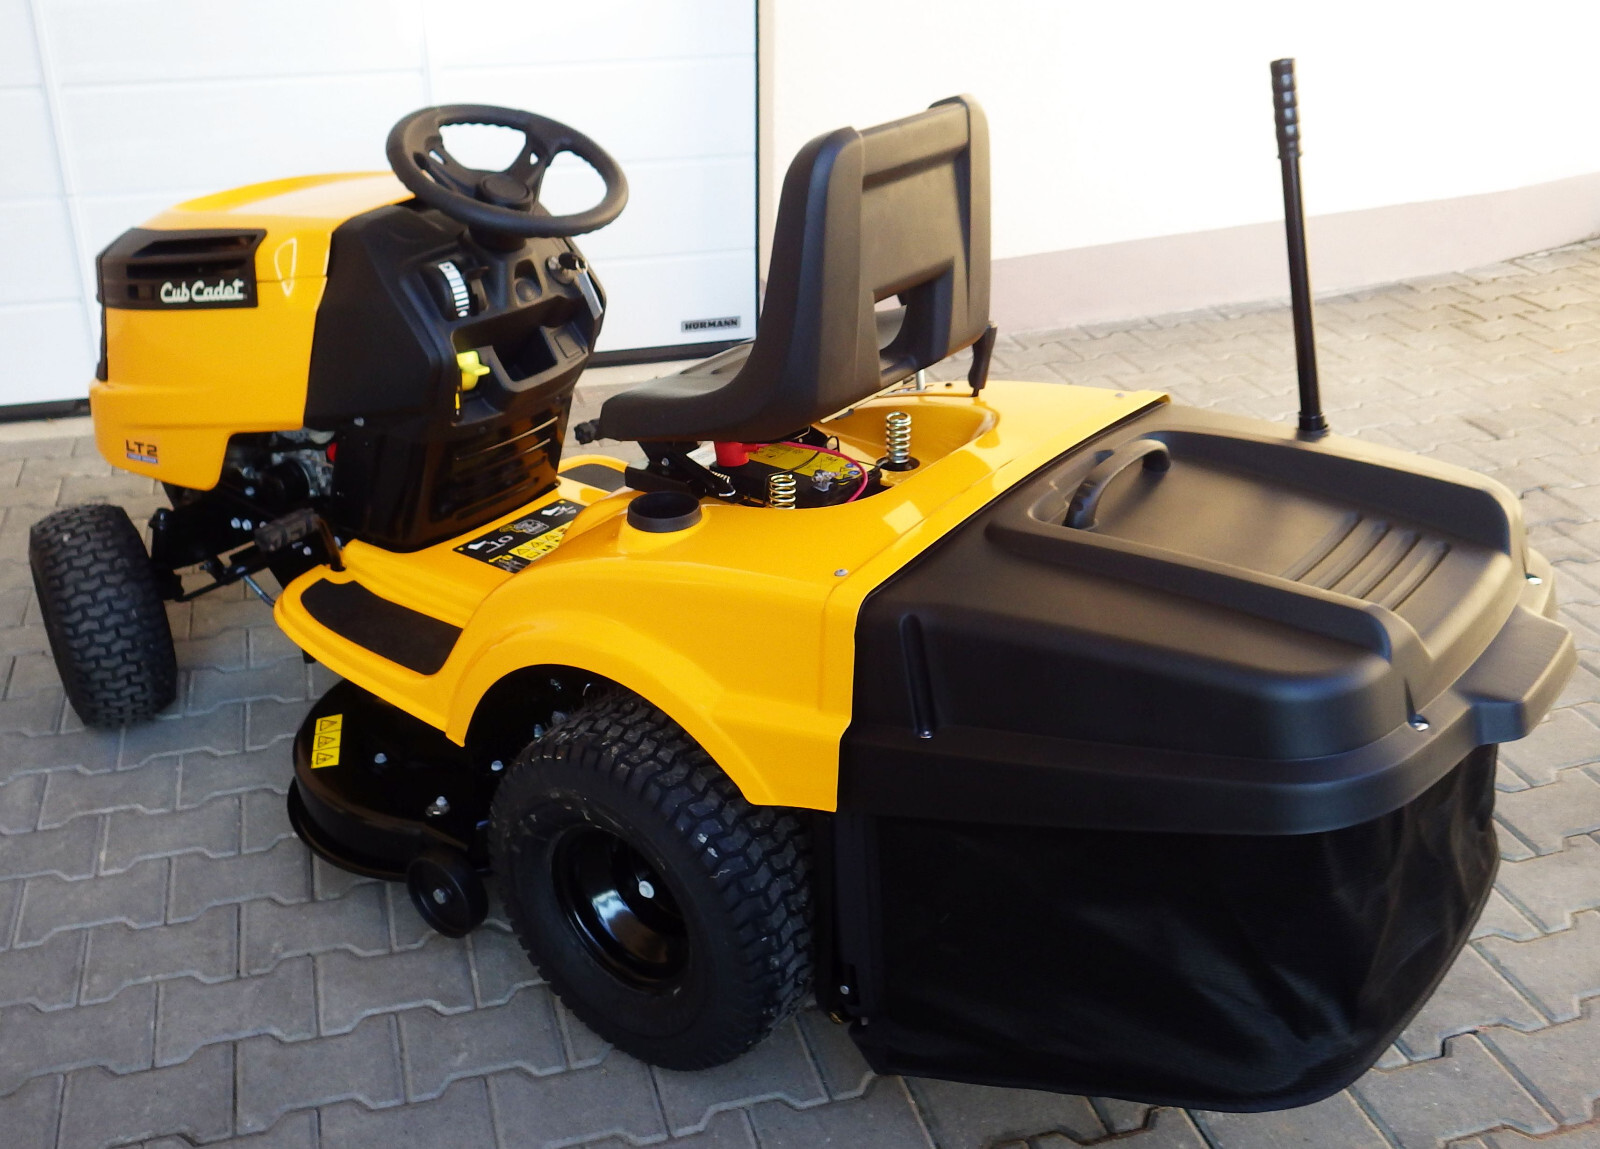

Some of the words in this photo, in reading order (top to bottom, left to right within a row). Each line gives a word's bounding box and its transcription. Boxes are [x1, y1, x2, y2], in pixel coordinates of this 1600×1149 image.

[160, 281, 190, 303] Cub
[191, 279, 245, 302] Cadet
[125, 439, 158, 457] LT2
